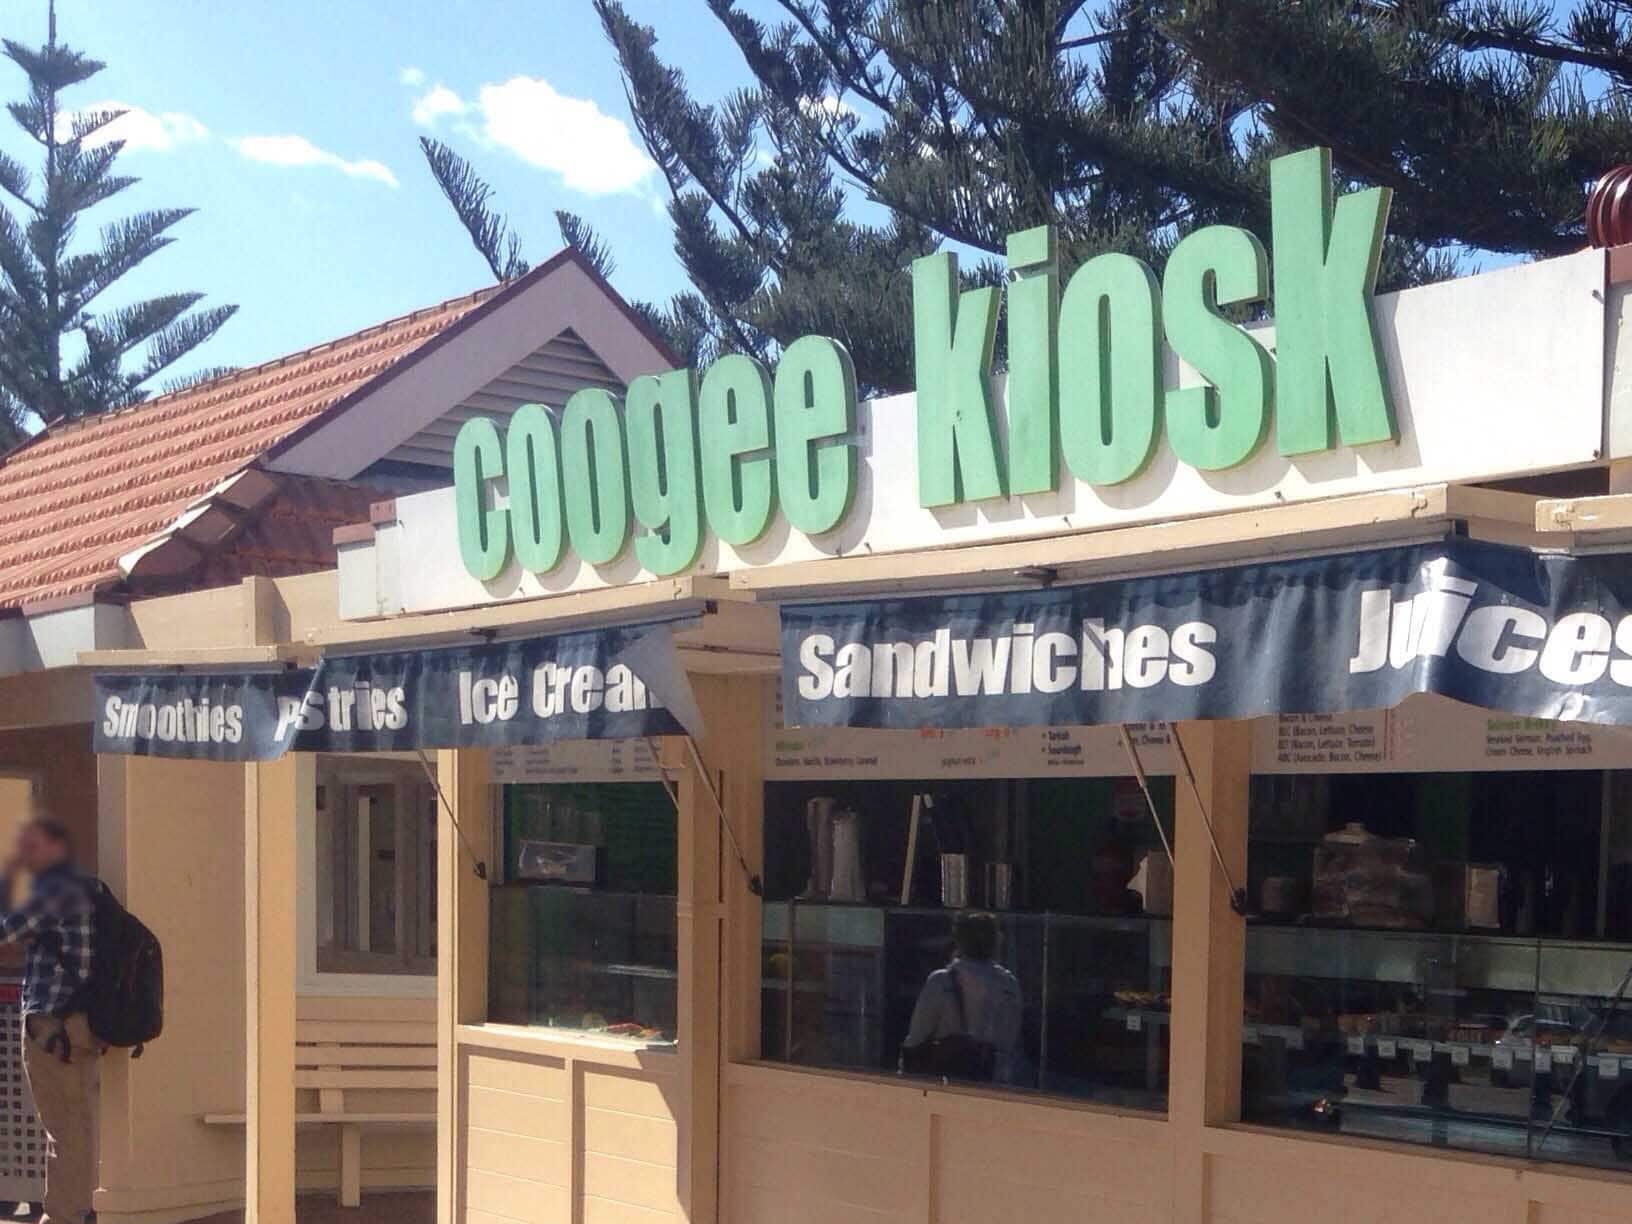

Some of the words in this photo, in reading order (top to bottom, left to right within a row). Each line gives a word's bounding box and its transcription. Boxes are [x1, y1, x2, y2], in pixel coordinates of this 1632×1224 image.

[453, 331, 857, 582] coogee
[912, 146, 1398, 507] kiosk
[798, 617, 1217, 700] Sandwiches
[103, 695, 242, 744] Smoothies
[274, 681, 408, 742] Pstries
[459, 669, 519, 726] Ice
